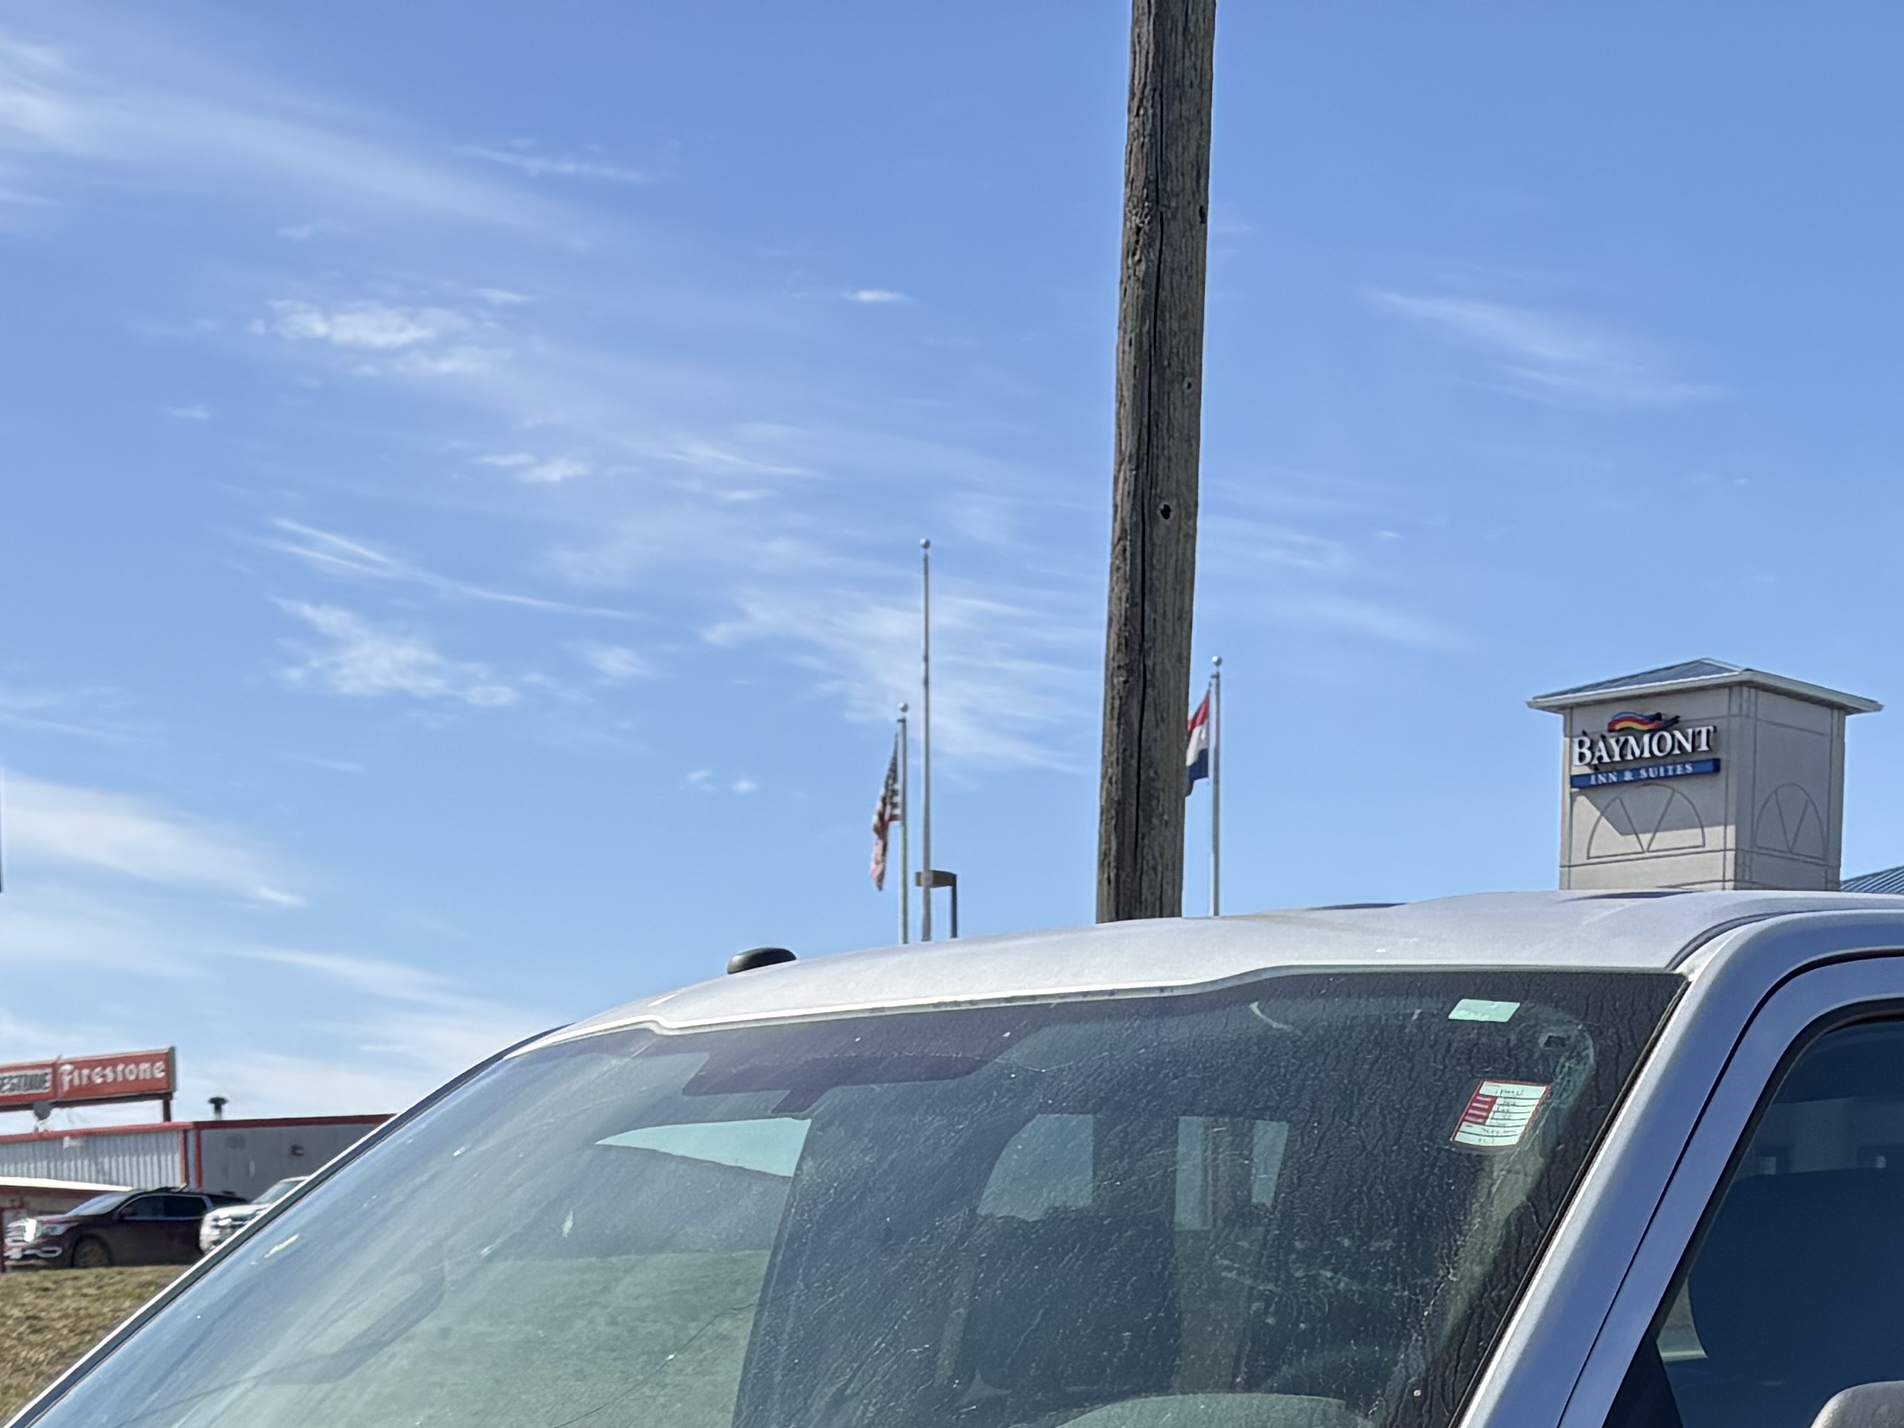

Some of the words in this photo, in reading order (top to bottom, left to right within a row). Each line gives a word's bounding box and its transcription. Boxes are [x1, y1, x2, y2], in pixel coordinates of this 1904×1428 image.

[1571, 724, 1715, 768] BAYMONT
[1589, 772, 1618, 786] INN
[1623, 768, 1634, 782] &
[1638, 762, 1695, 779] SUITES
[58, 1060, 166, 1092] Firestone
